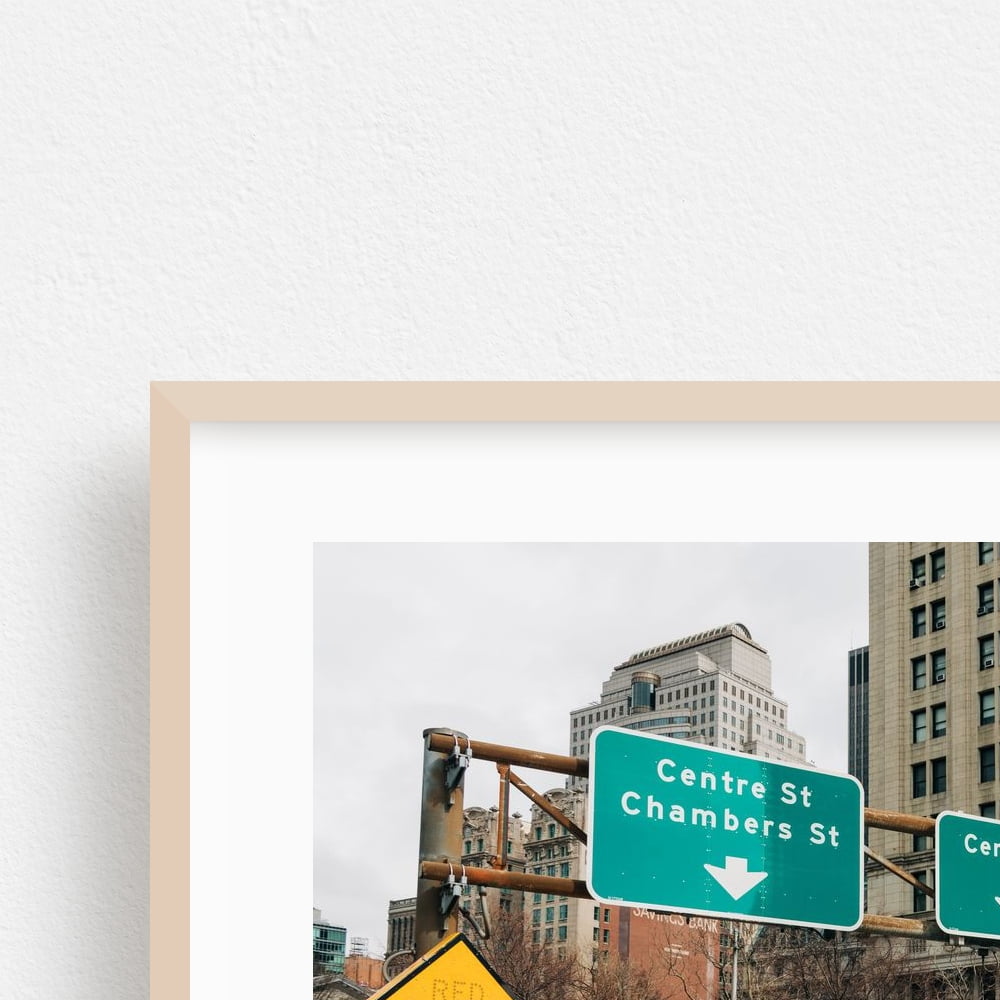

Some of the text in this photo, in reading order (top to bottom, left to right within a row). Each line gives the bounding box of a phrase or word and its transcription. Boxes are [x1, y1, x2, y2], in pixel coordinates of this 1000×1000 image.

[657, 758, 811, 808] Centre St
[621, 791, 839, 847] Chambers St
[688, 916, 718, 933] BANK
